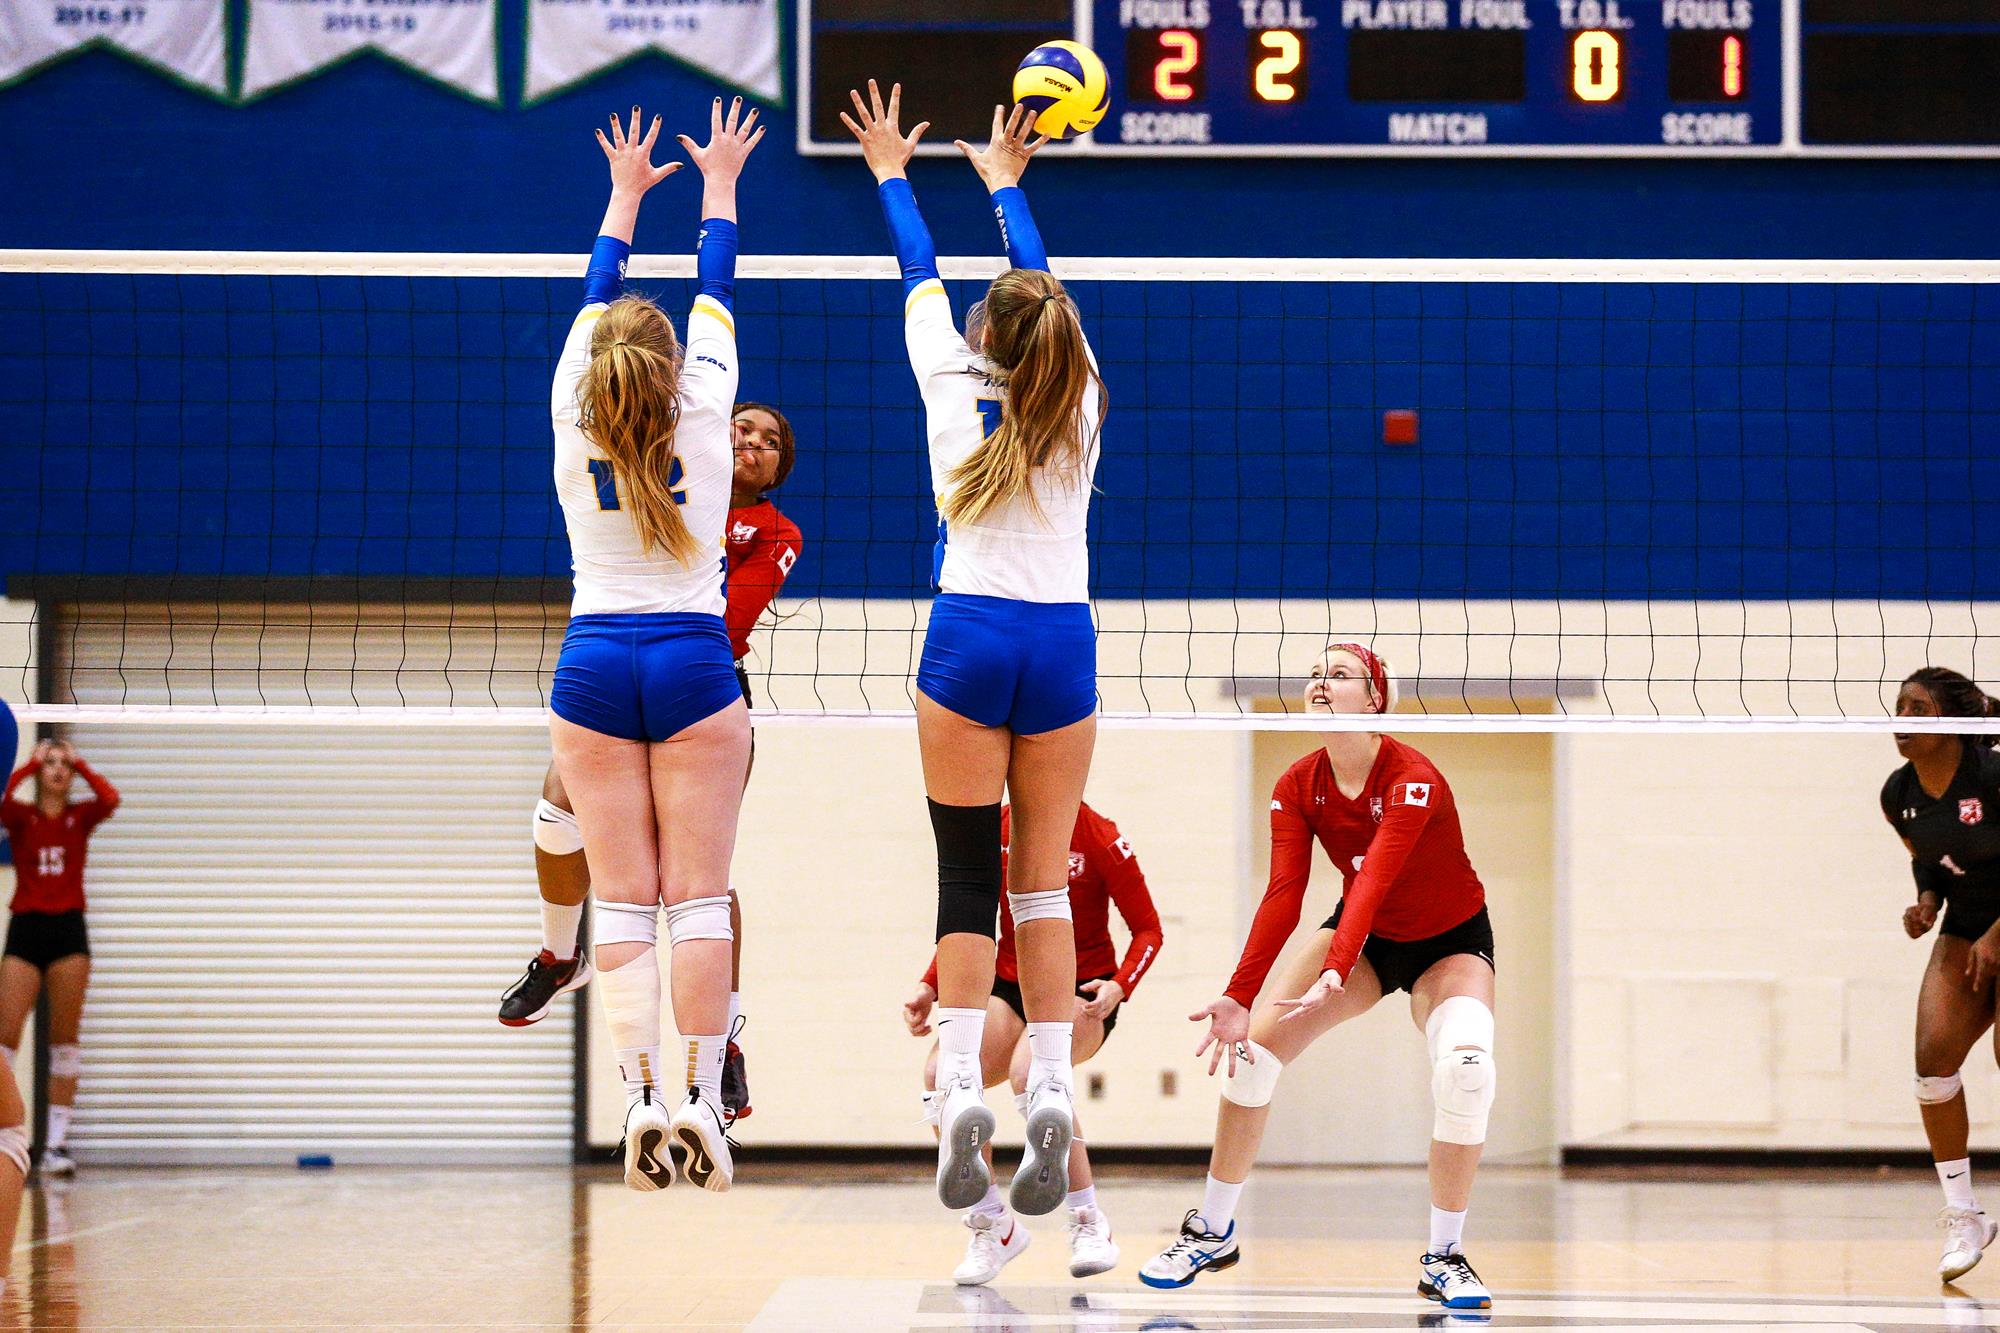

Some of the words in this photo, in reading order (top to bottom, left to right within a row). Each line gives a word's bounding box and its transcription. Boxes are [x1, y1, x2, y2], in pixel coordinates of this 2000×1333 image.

[1119, 0, 1210, 28] FOULS
[1341, 0, 1448, 29] PLAYER
[1460, 0, 1532, 29] FOUL
[1662, 0, 1753, 29] FOULS
[1154, 31, 1199, 100] 2
[1255, 31, 1301, 101] 2
[1573, 31, 1619, 102] 0
[1723, 36, 1742, 96] 1
[1121, 112, 1212, 143] SCORE
[1388, 113, 1488, 144] MATCH
[1662, 112, 1752, 144] SCORE
[38, 846, 65, 875] 15
